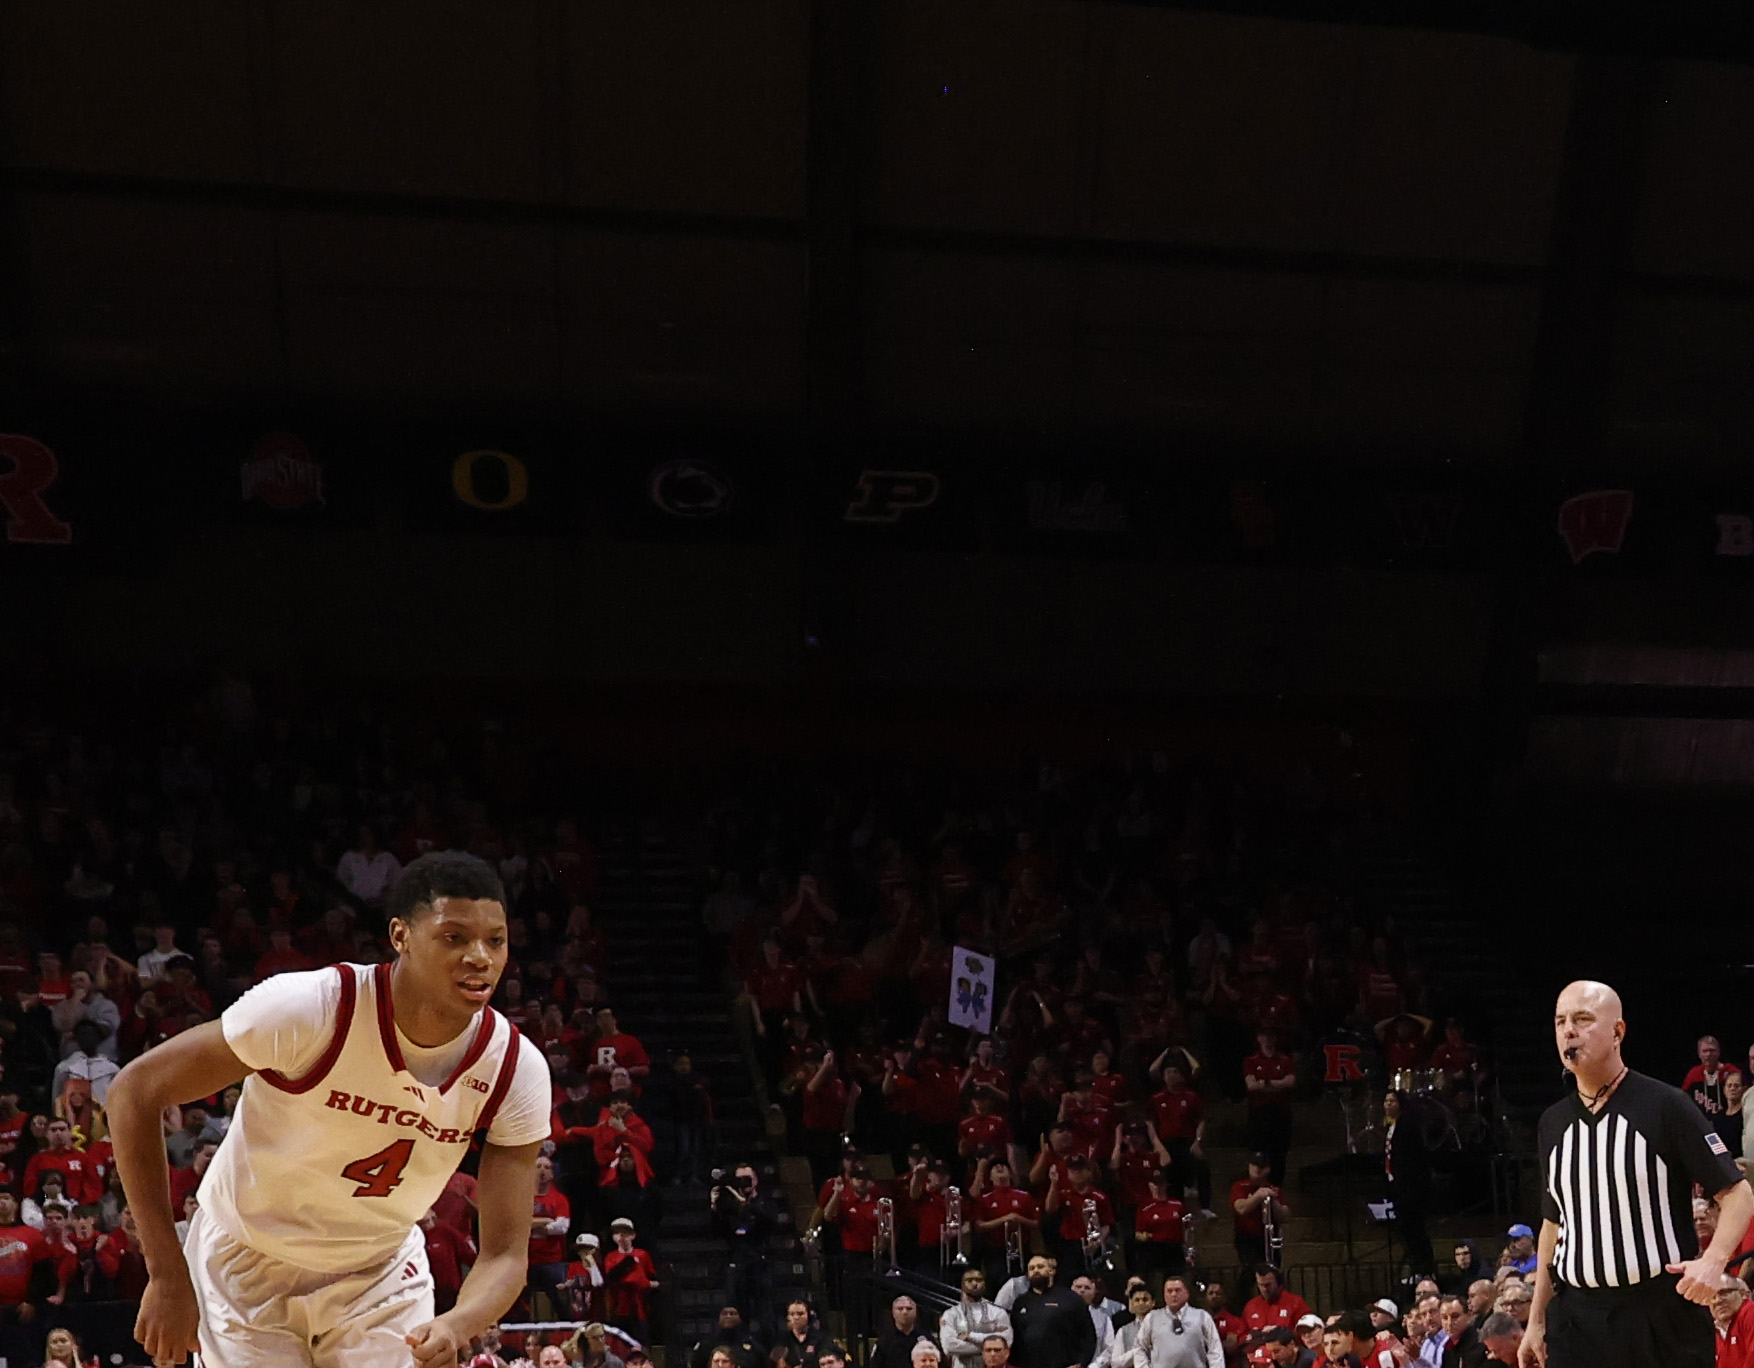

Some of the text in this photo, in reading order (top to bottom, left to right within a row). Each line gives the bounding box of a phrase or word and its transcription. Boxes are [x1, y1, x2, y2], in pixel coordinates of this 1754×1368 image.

[597, 1046, 617, 1066] R
[1323, 1044, 1365, 1083] R
[341, 1138, 416, 1197] 4
